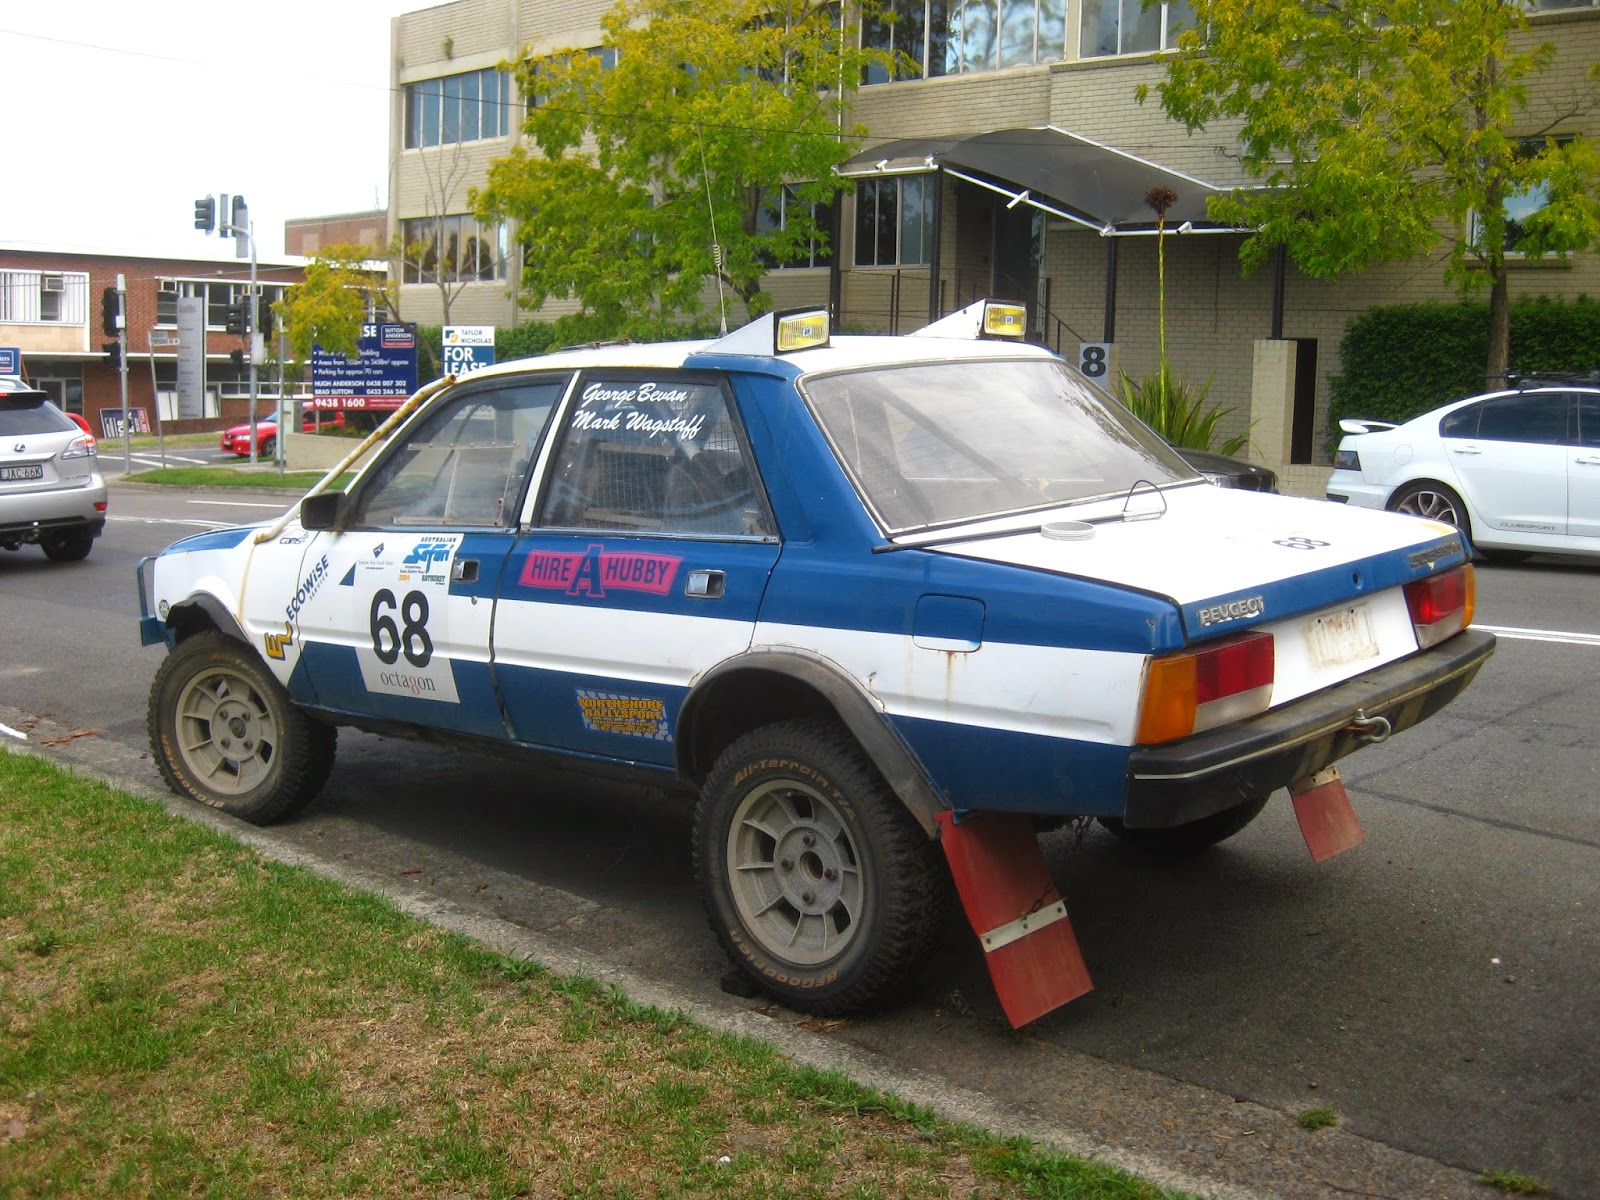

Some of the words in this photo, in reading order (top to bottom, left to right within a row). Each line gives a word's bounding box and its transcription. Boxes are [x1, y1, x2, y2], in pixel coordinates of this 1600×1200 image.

[444, 347, 474, 362] FOR
[1081, 346, 1106, 378] 8
[318, 368, 336, 376] Parking
[315, 398, 338, 408] 9438
[342, 398, 365, 408] 1600
[580, 382, 636, 408] George
[636, 382, 688, 402] Bevan
[572, 410, 622, 430] Mark
[626, 412, 706, 440] Wagstaff
[1500, 522, 1556, 531] CLUBSPORT
[1272, 536, 1332, 550] 68
[531, 556, 573, 582] HIRE
[566, 544, 606, 598] A
[605, 556, 671, 586] HUBBY
[1198, 596, 1264, 626] PEUGEOT
[370, 588, 434, 668] 68
[380, 672, 437, 696] octagon
[578, 698, 664, 710] NORTHSHORE
[584, 708, 662, 720] RALLYSPORT
[733, 758, 828, 788] All-Terrain
